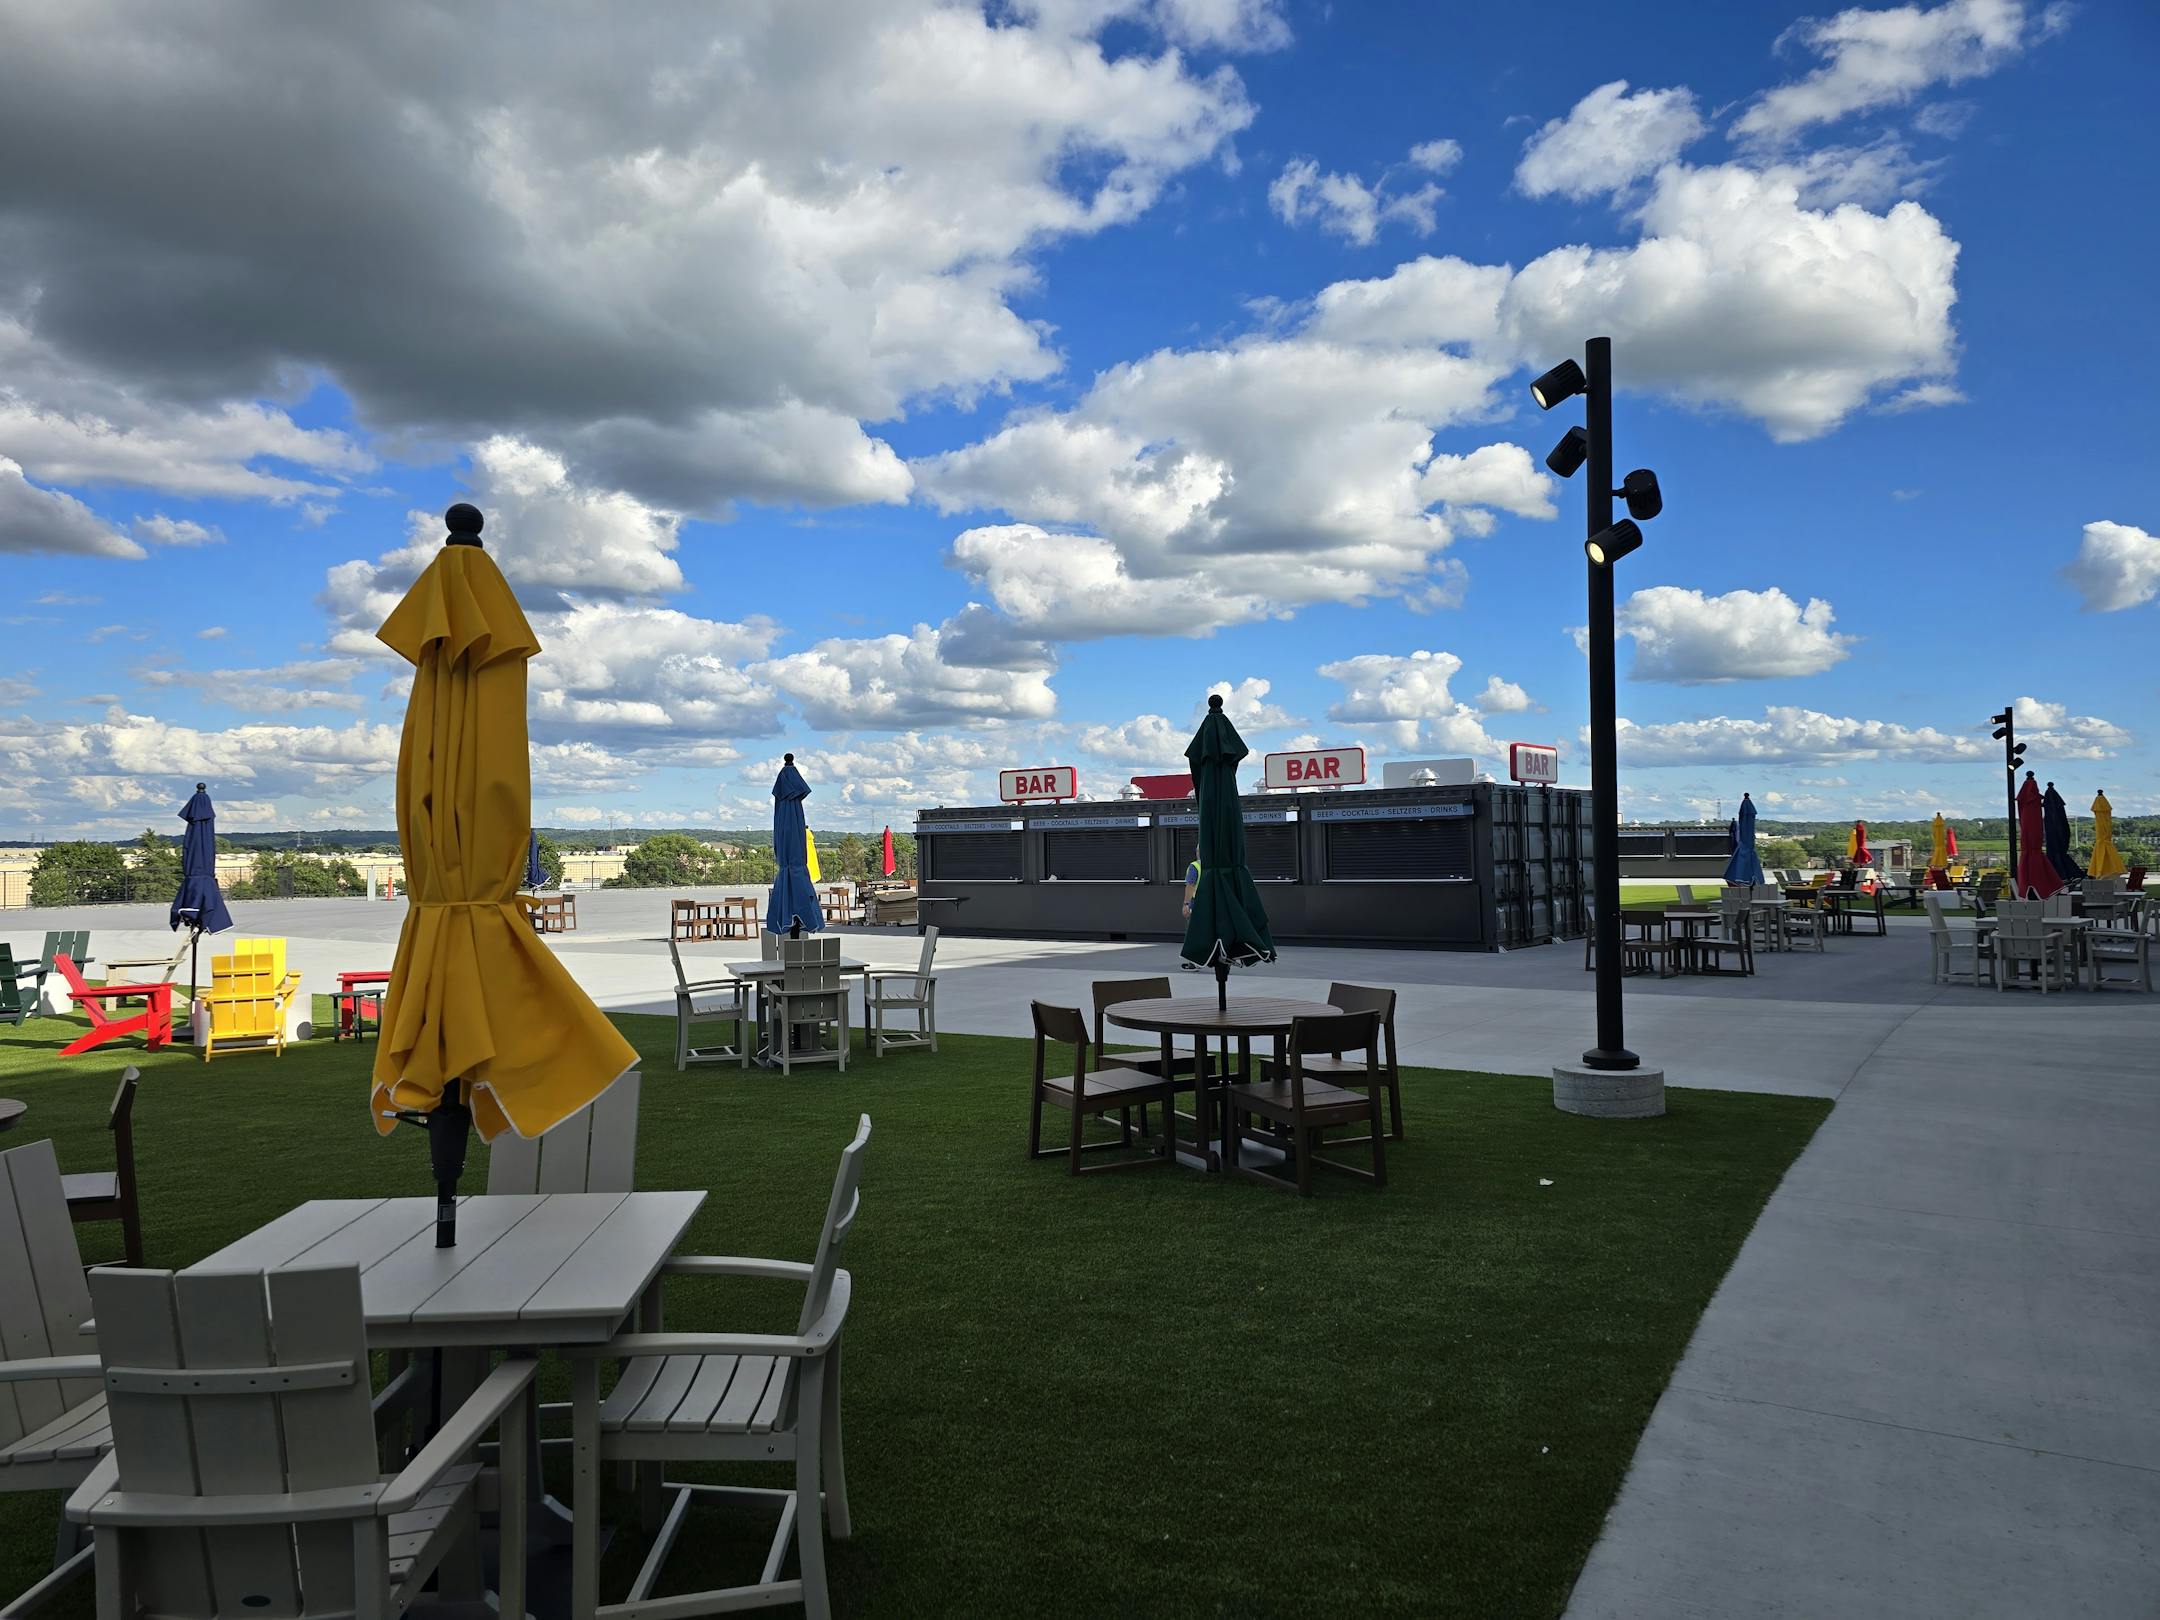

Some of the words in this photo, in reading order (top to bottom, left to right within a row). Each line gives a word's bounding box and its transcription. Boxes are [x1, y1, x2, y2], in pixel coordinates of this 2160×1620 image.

[1286, 757, 1340, 781] BAR
[1525, 751, 1549, 776] BAR
[1015, 774, 1057, 795] BAR
[1258, 812, 1282, 820] DRINKS
[1341, 809, 1380, 817] COCKTAILS
[1387, 807, 1422, 815] SELTZERS
[1430, 805, 1458, 813] DRINKS
